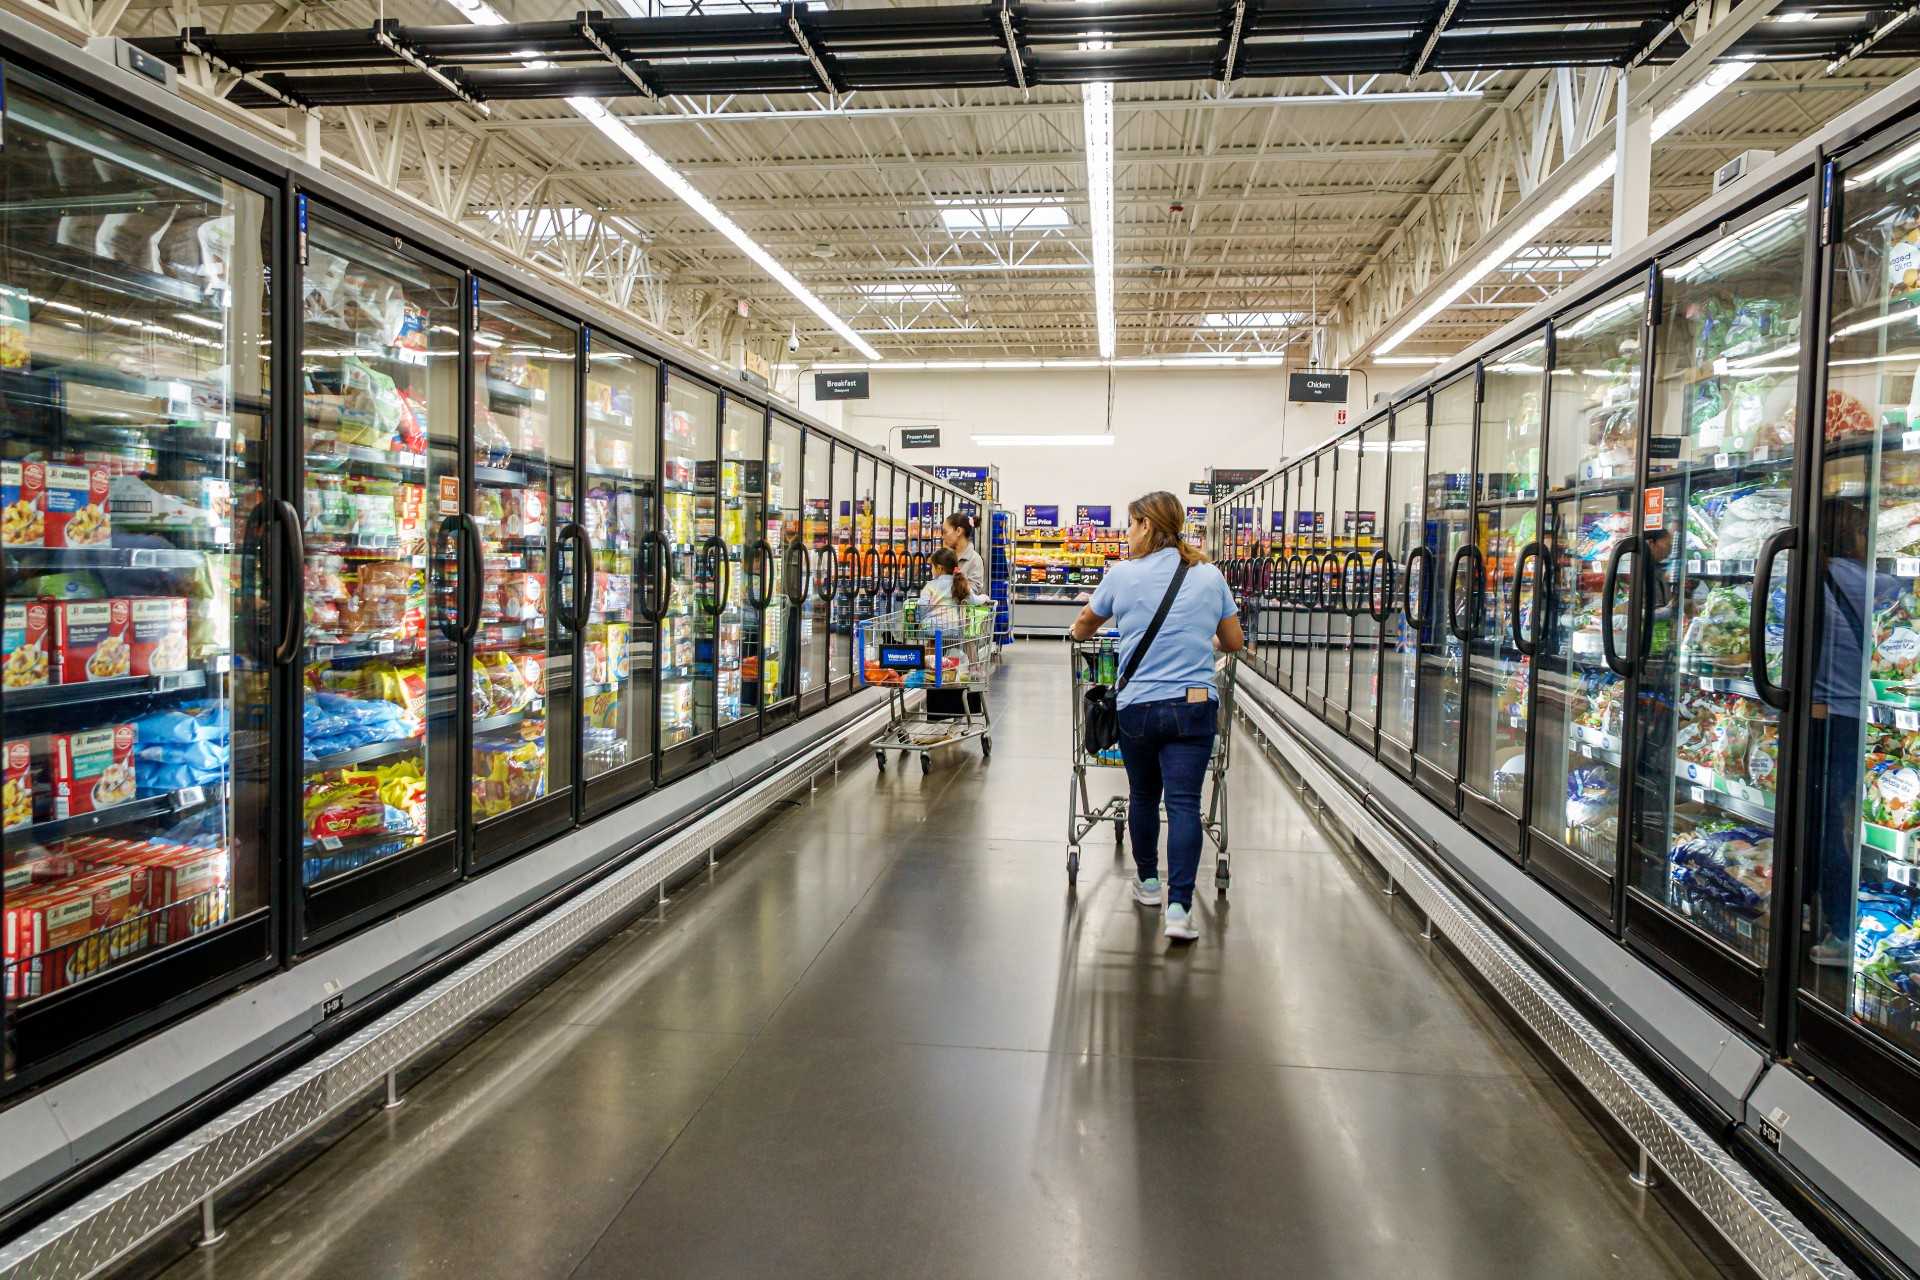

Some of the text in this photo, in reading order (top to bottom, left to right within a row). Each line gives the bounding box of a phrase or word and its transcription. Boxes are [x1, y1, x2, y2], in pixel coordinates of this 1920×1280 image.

[826, 379, 857, 387] Breakfast
[1307, 381, 1331, 389] Chicken
[960, 471, 977, 479] Price
